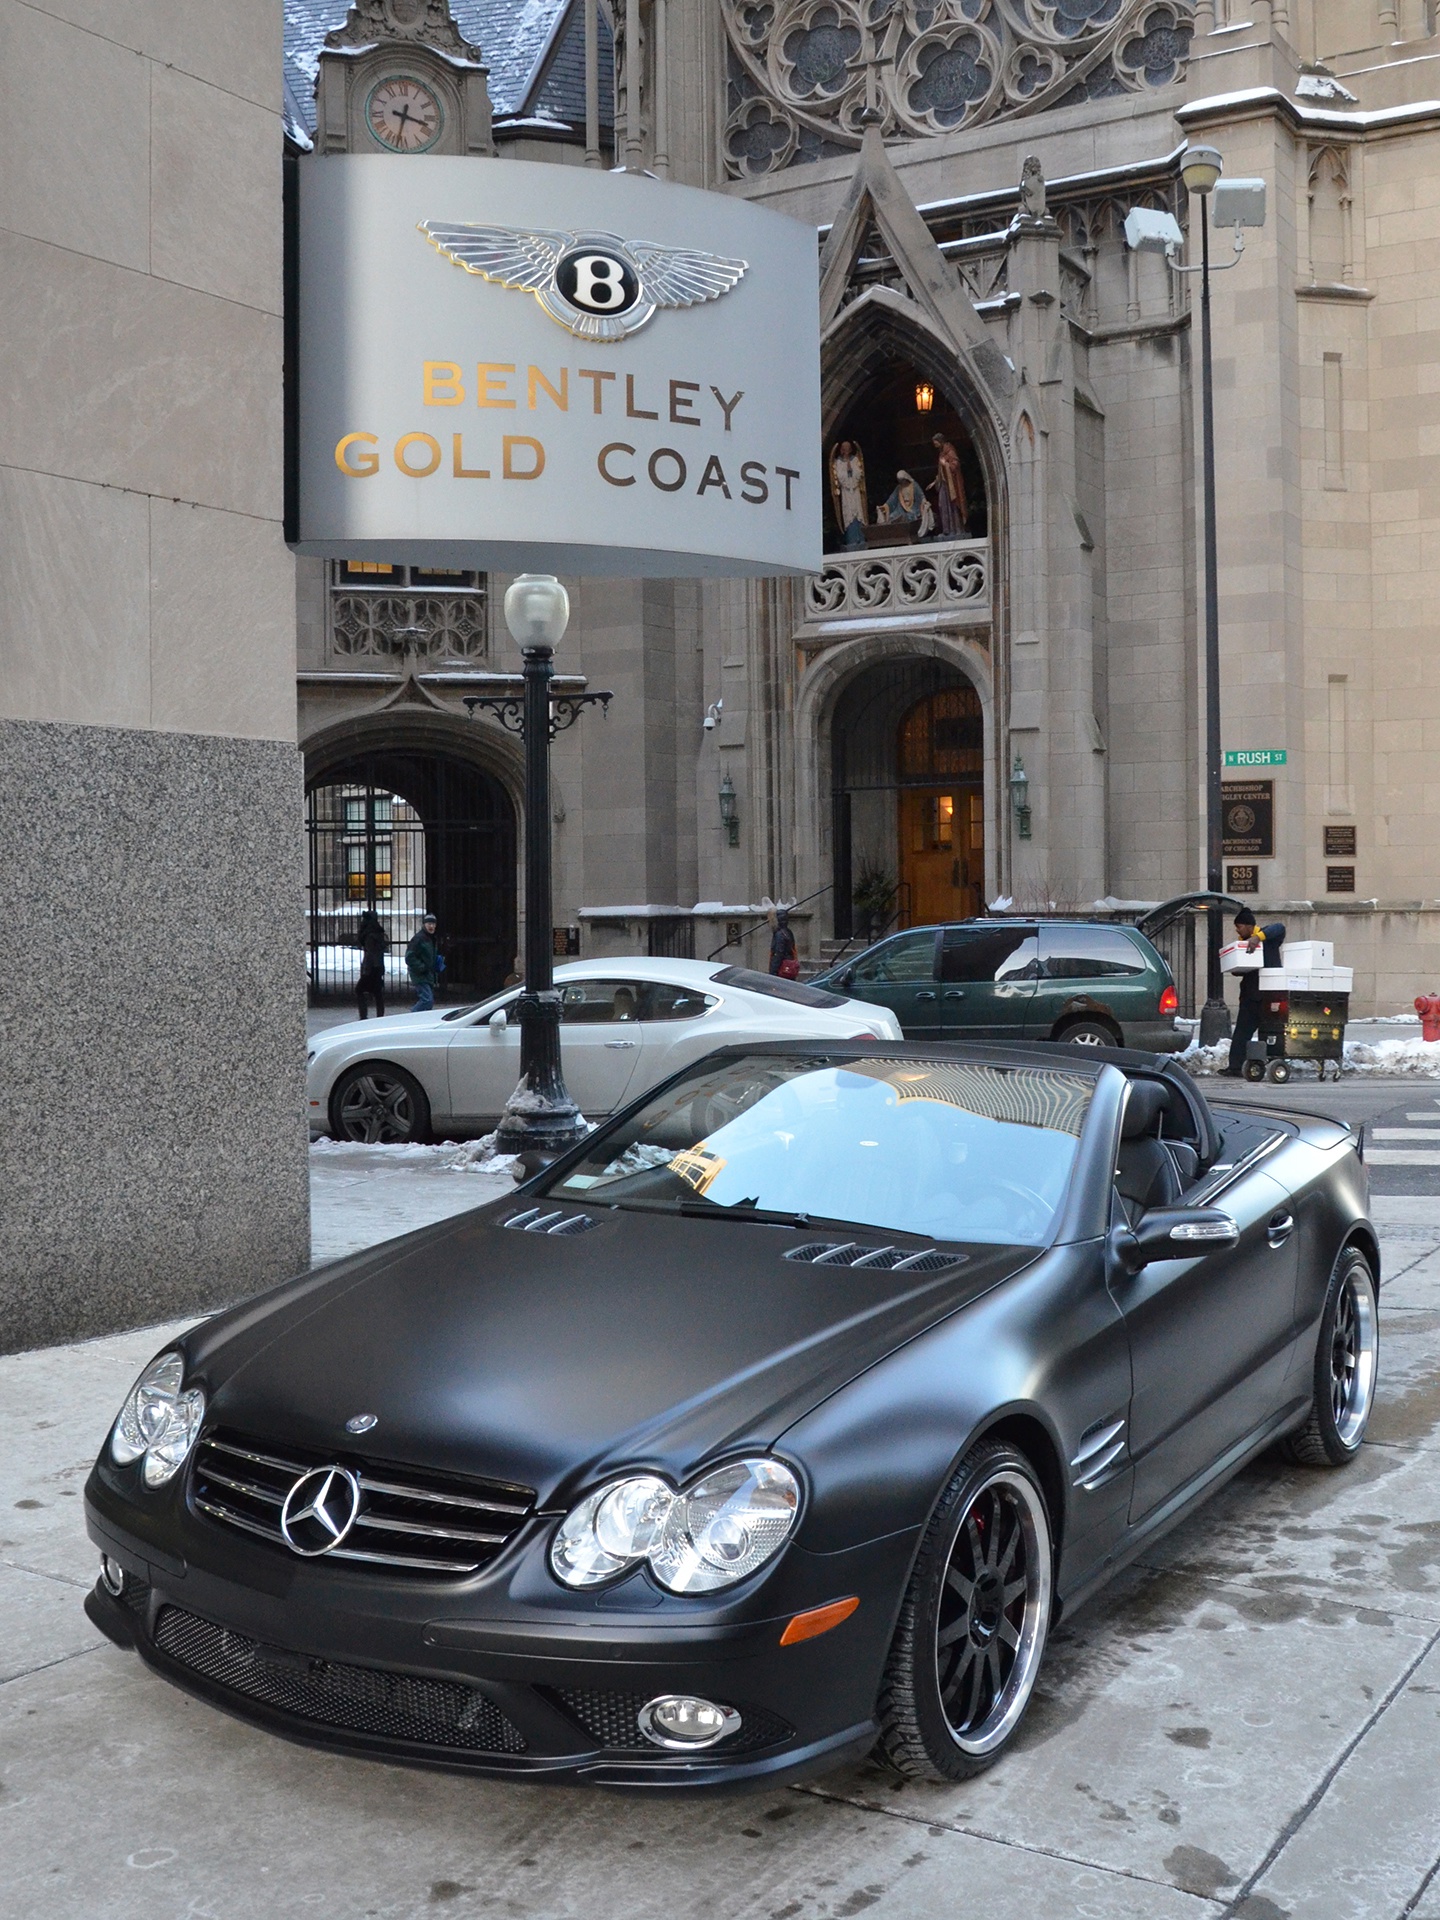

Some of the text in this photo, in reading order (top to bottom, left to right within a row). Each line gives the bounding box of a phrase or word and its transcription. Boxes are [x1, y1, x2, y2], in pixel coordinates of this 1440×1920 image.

[571, 255, 628, 310] B
[422, 360, 746, 432] BENTLEY
[333, 431, 801, 512] GOLD COAST
[1237, 752, 1271, 764] RUSH
[1274, 753, 1283, 761] ST
[1222, 792, 1271, 801] IGLEY CENTER
[1232, 867, 1253, 879] 835
